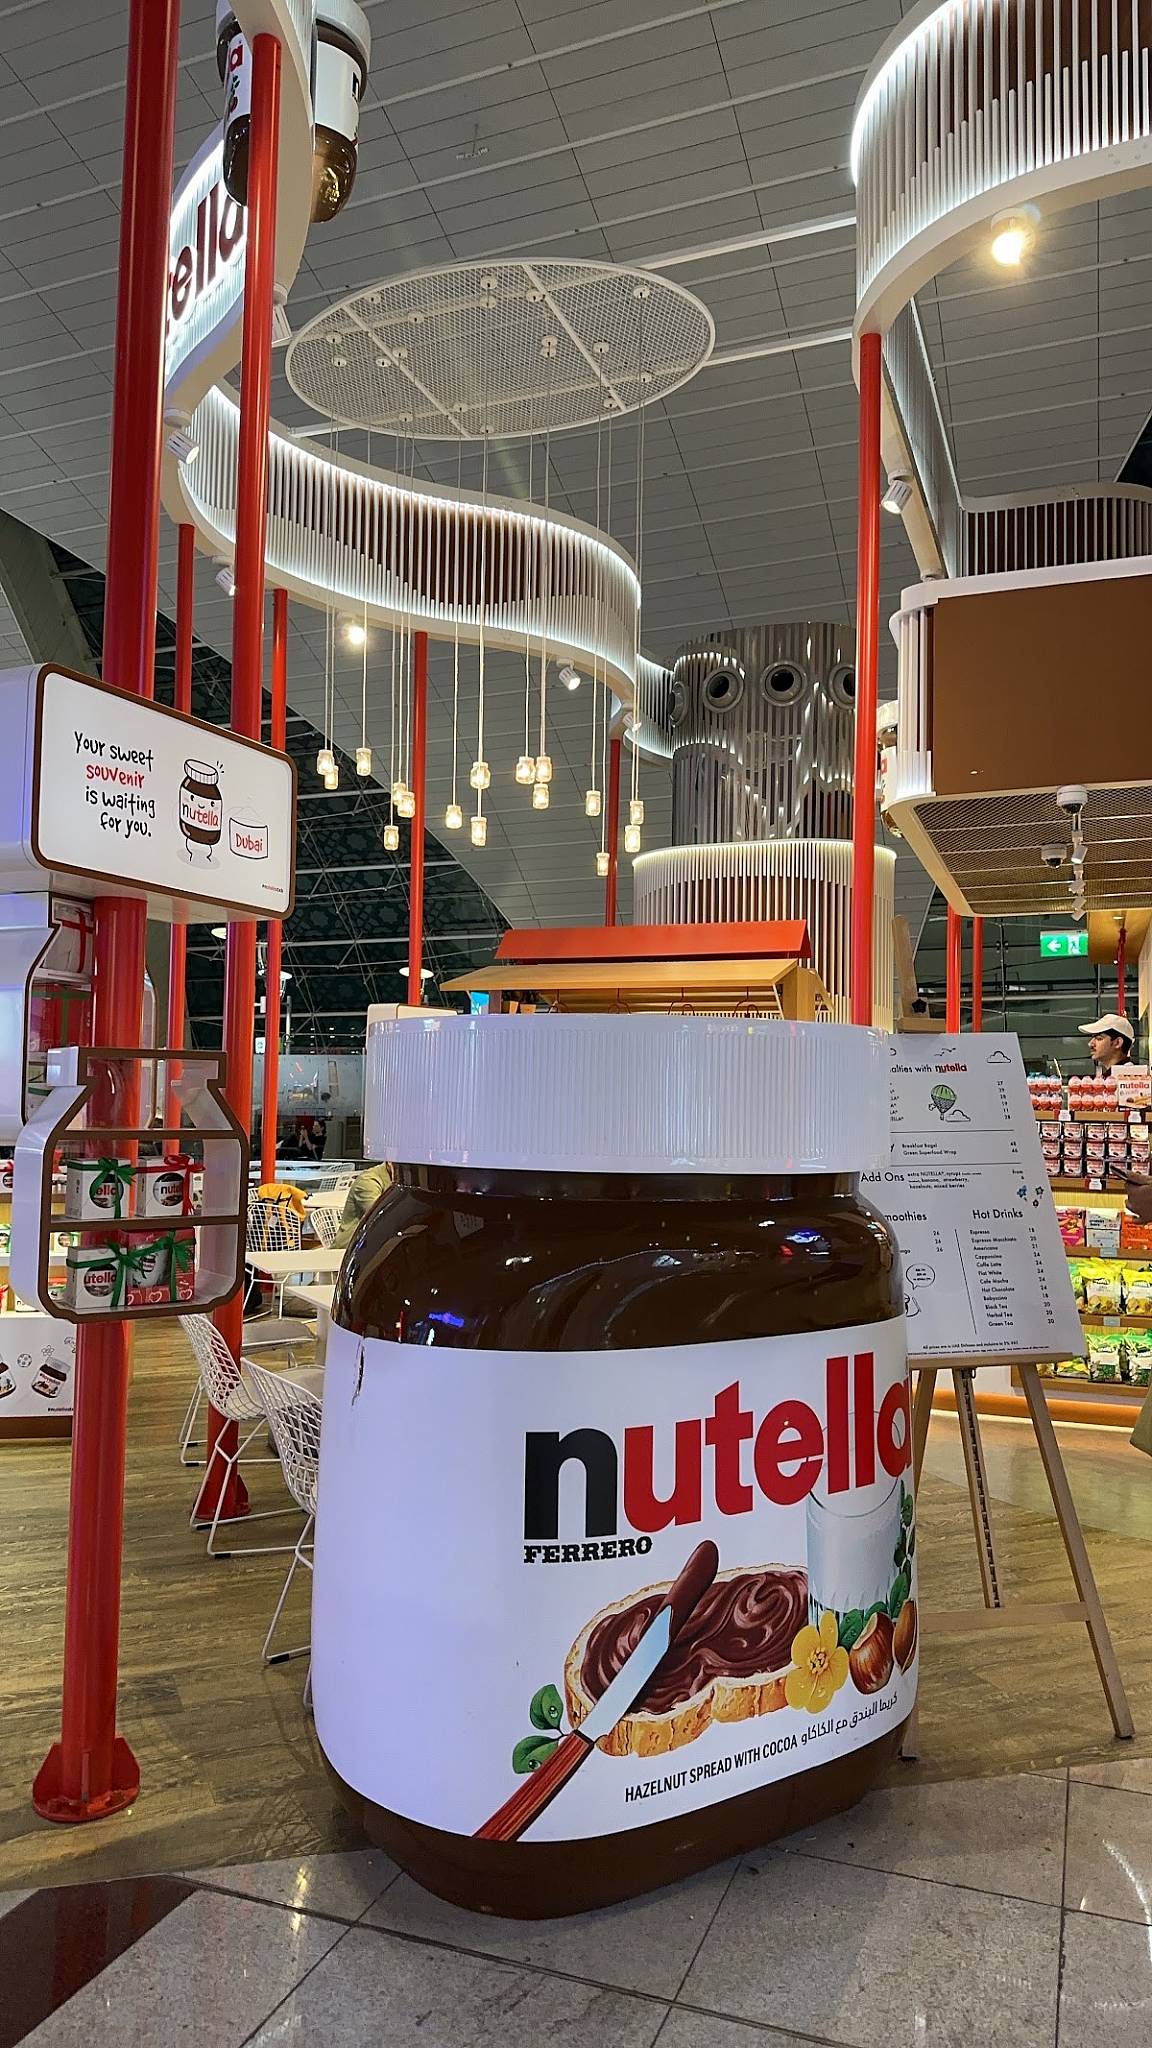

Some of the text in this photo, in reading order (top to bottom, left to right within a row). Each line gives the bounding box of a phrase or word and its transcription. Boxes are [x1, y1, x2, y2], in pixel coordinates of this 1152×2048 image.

[74, 731, 154, 772] Your sweet
[86, 764, 145, 789] souvenir
[85, 786, 156, 818] is waiting
[181, 802, 219, 827] nutella
[100, 812, 152, 838] for you.
[236, 832, 263, 852] Dubai
[915, 1064, 932, 1073] with
[935, 1063, 968, 1073] nutella
[860, 1172, 905, 1182] Add Ons
[972, 1208, 1023, 1219] Hot Drinks
[524, 1352, 912, 1540] nutella
[523, 1536, 654, 1564] FERRERO
[801, 1690, 898, 1746] كريما البندق مع الكاكاو
[625, 1734, 798, 1802] HAZELNUT SPREAD WITH COCOA
